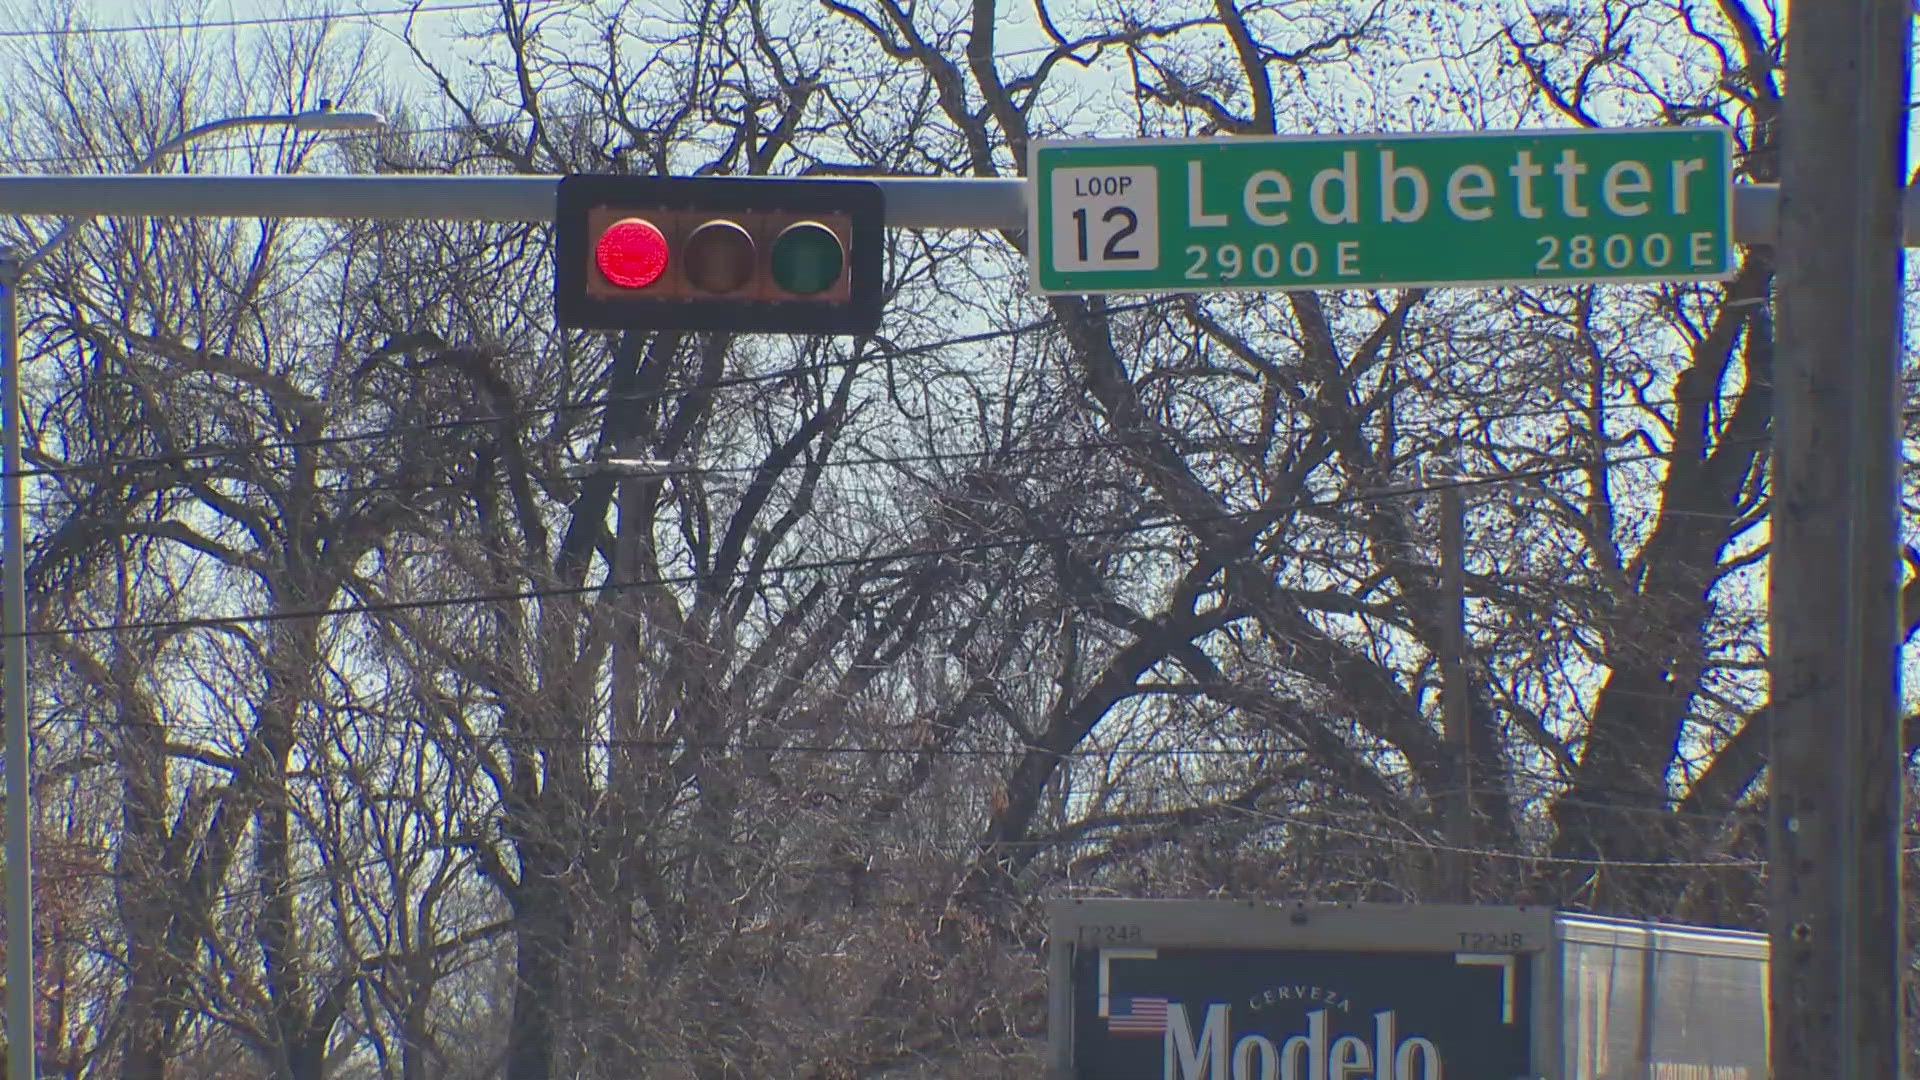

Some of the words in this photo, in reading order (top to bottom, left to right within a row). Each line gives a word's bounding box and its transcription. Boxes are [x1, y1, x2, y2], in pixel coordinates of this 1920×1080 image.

[1075, 176, 1133, 197] LOOP
[1186, 148, 1706, 228] Ledbetter
[1072, 205, 1140, 262] 12
[1535, 232, 1672, 271] 2800
[1689, 231, 1714, 266] E
[1184, 242, 1320, 280] 2900
[1336, 240, 1361, 276] E
[1249, 984, 1350, 1013] CERVEZA
[1162, 1002, 1443, 1080] Modelo
